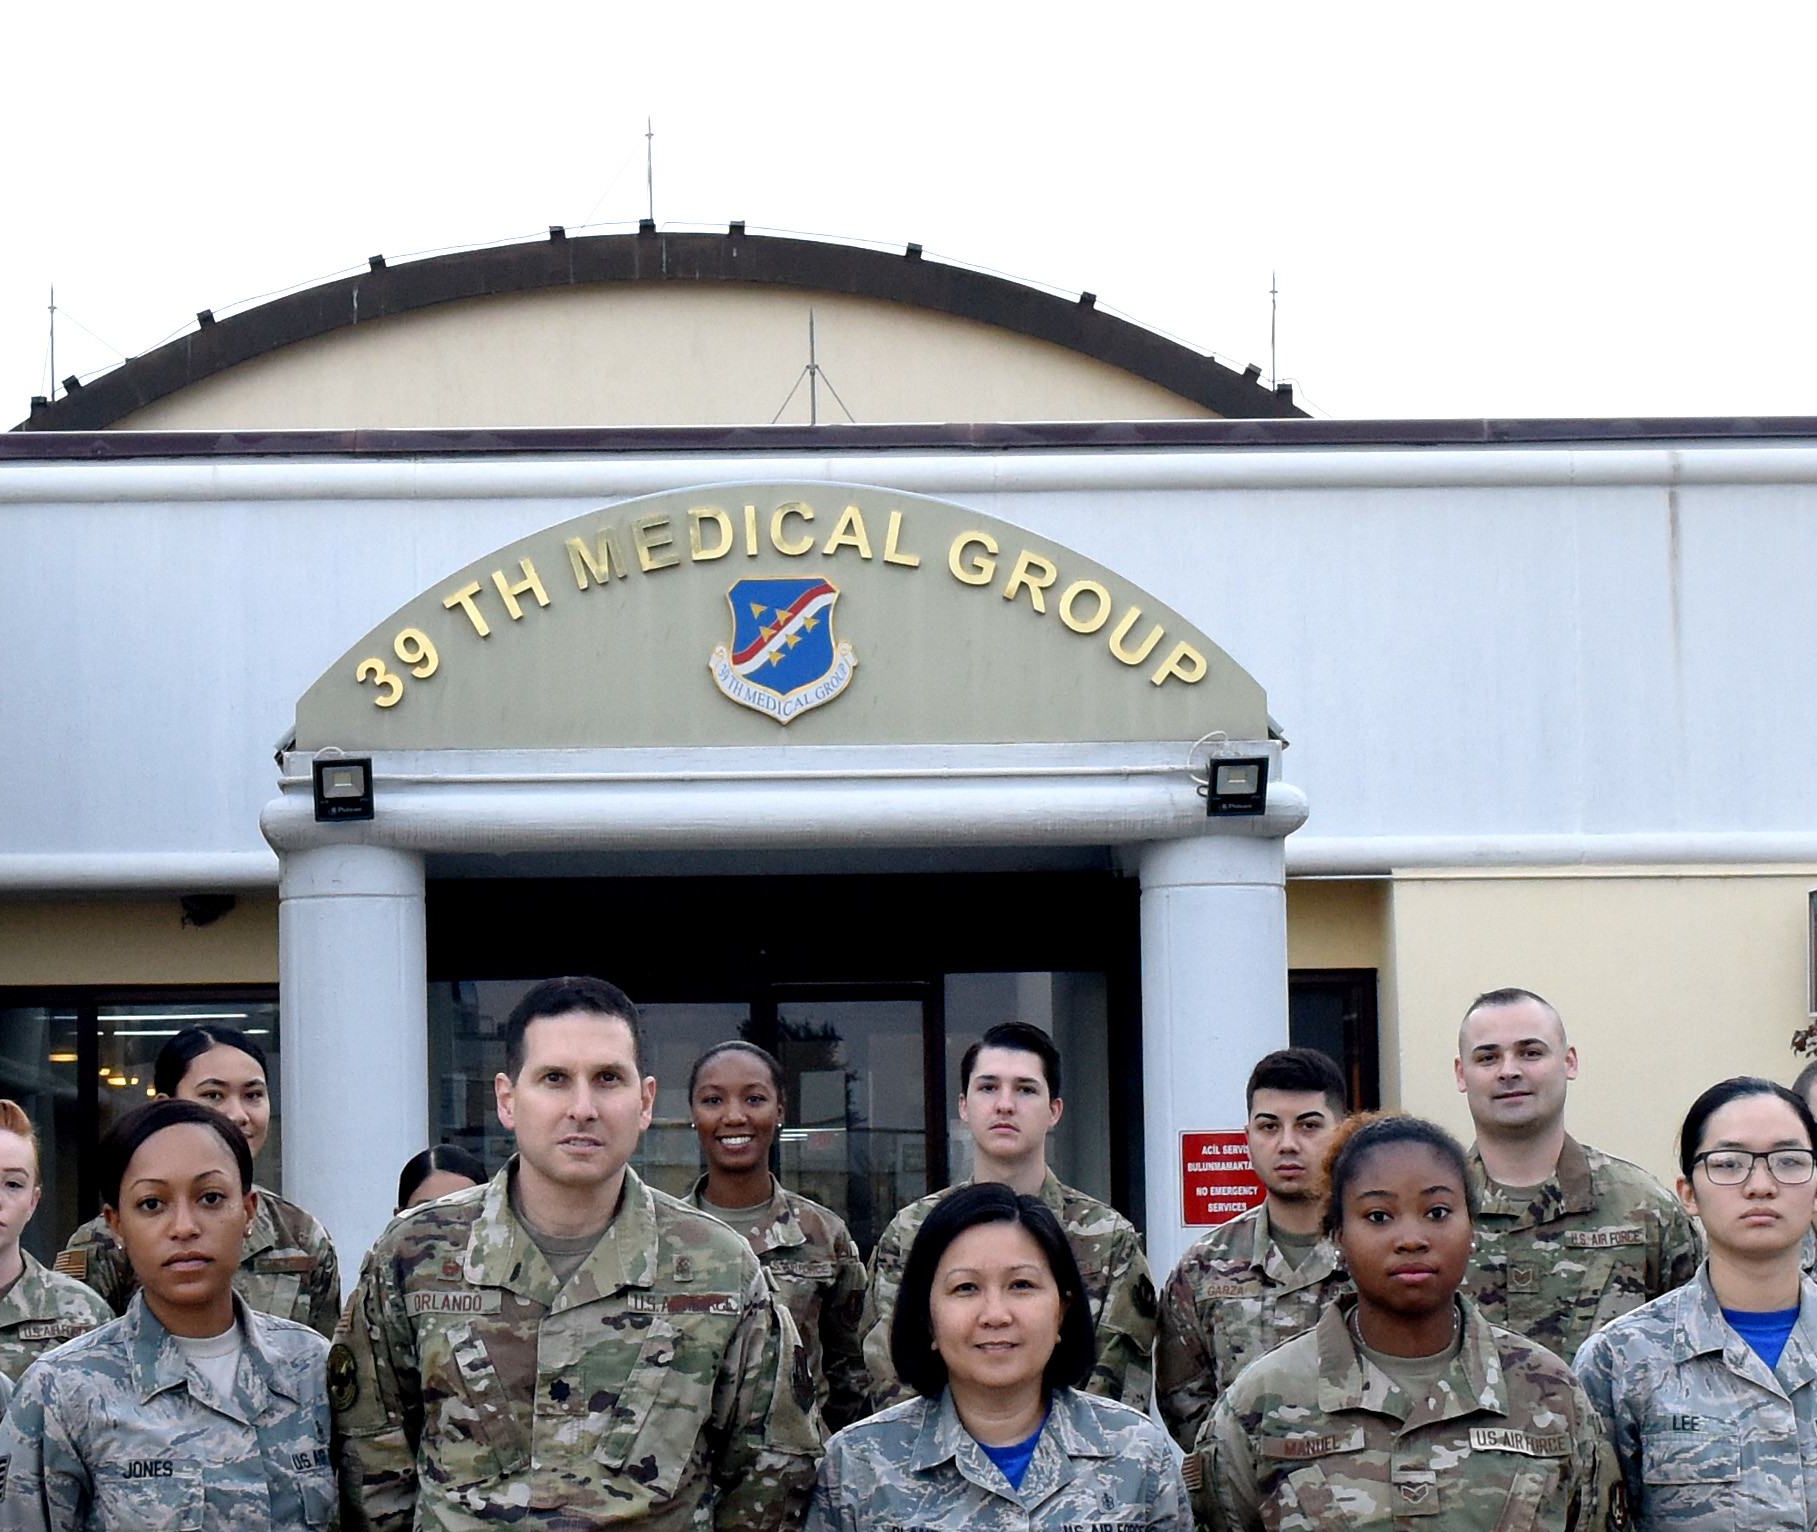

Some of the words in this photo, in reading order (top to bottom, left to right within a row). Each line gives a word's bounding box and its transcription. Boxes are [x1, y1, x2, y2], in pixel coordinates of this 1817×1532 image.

[355, 627, 441, 708] 39
[442, 556, 552, 638] TH
[563, 501, 922, 591] MEDICAL
[948, 530, 1209, 687] GROUP
[728, 678, 743, 695] TH
[745, 686, 812, 716] MEDICAL
[815, 662, 848, 699] GROUP
[1196, 1187, 1209, 1196] NO
[1210, 1186, 1259, 1196] EMERGENCY
[1208, 1202, 1247, 1213] SERVICES
[1591, 1233, 1608, 1246] AIR
[1609, 1230, 1641, 1244] FORCE
[1207, 1285, 1245, 1297] GARZA
[413, 1294, 483, 1312] ORLANDO
[1672, 1414, 1700, 1431] LEE
[1284, 1437, 1340, 1455] MANUEL
[1502, 1431, 1525, 1449] AIR
[1525, 1435, 1566, 1452] FORCE
[123, 1460, 174, 1480] JONES
